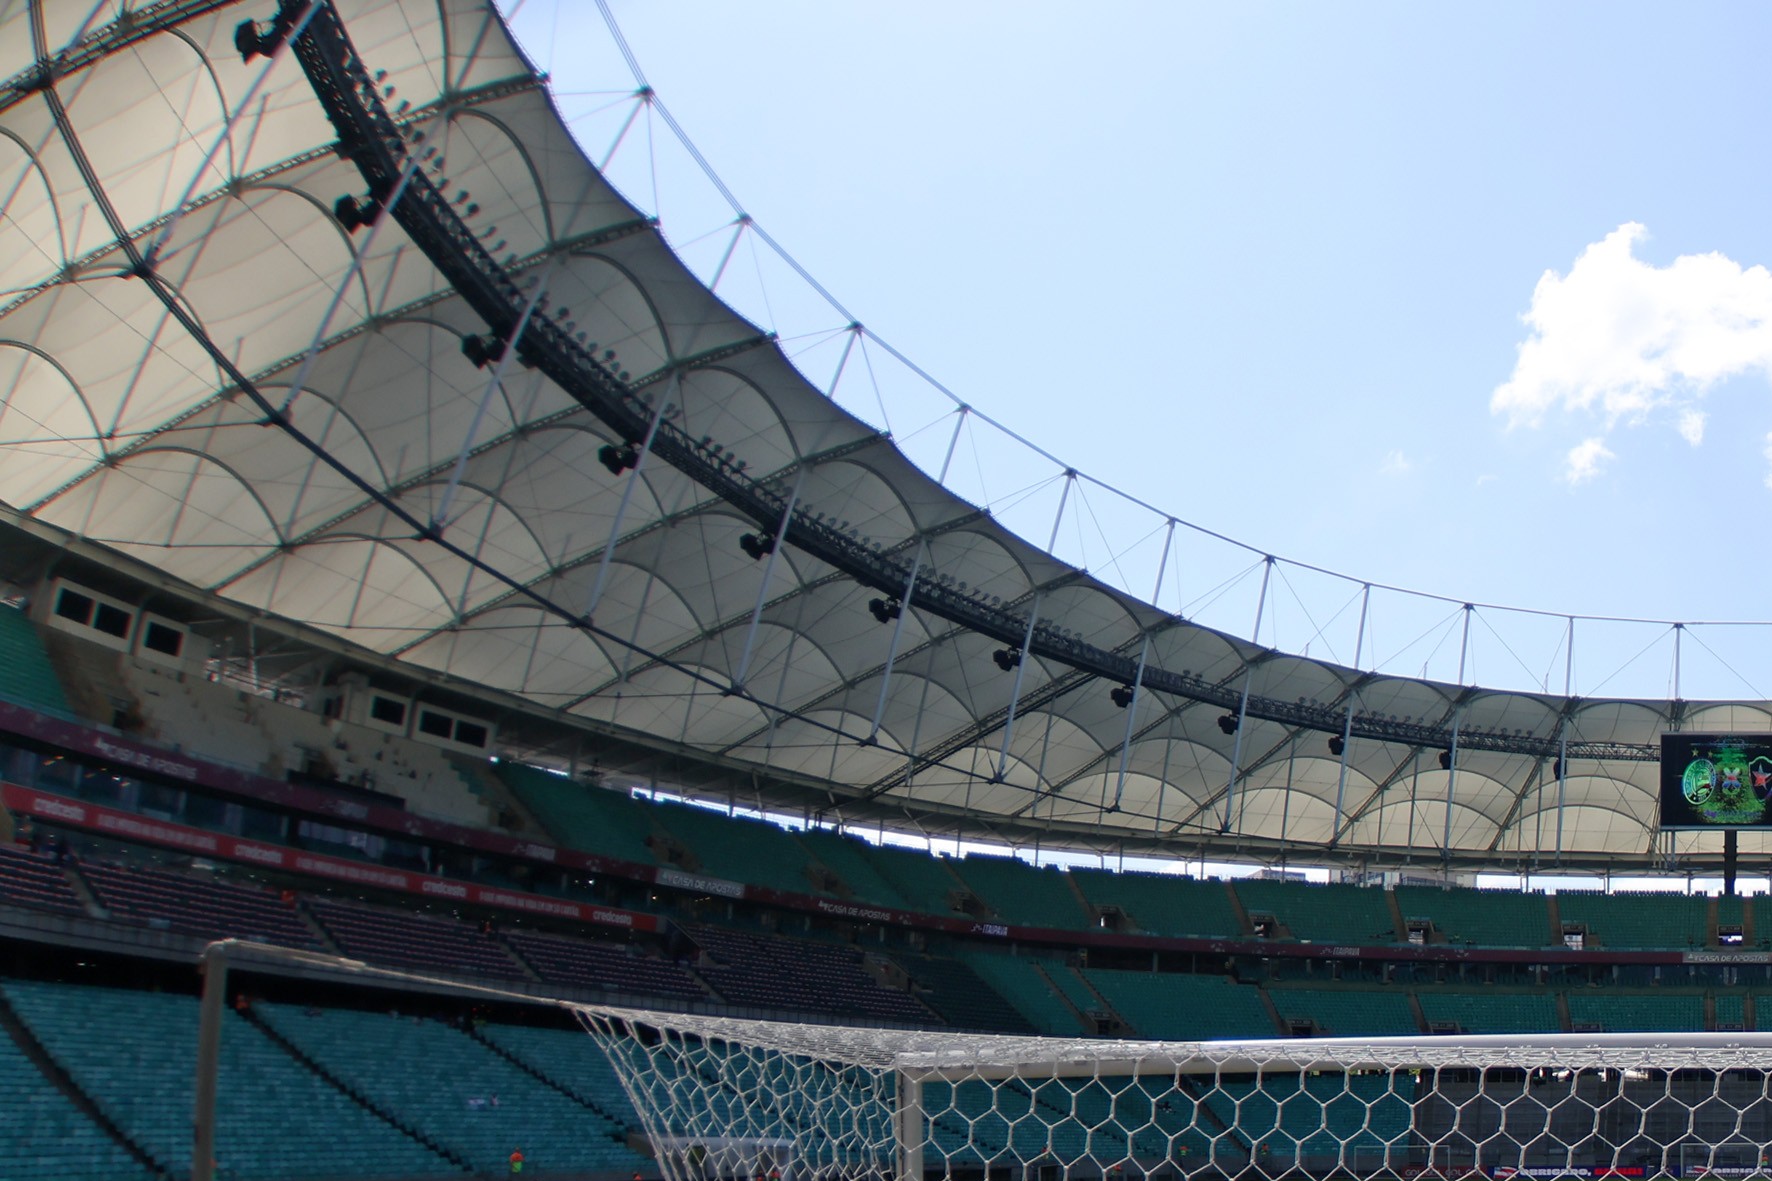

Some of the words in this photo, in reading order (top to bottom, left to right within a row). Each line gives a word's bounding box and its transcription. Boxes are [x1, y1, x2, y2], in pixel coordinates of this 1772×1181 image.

[672, 874, 693, 887] CASA
[693, 878, 705, 890] DE
[706, 880, 742, 897] APOSTAS
[827, 903, 848, 915] CASA
[857, 907, 891, 921] APOSTAS
[1699, 954, 1720, 963] CASA
[1732, 954, 1769, 963] APOSTAS
